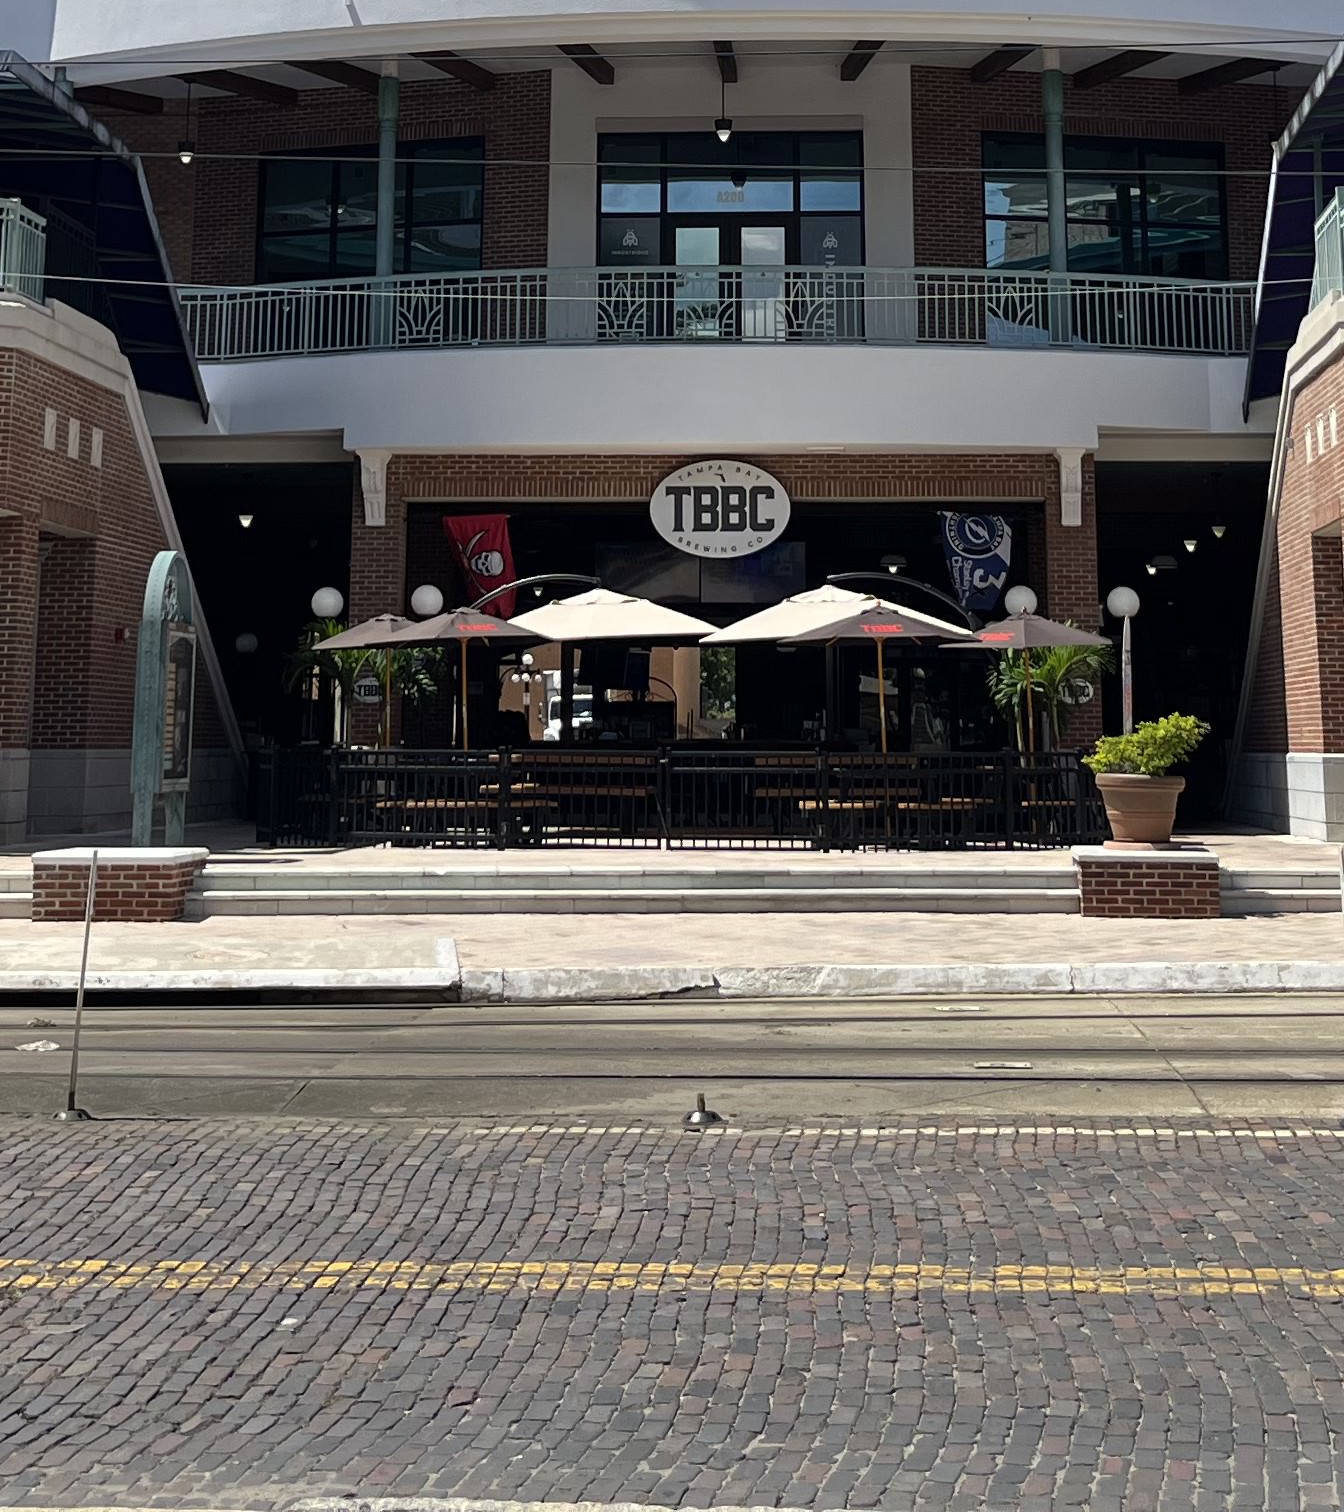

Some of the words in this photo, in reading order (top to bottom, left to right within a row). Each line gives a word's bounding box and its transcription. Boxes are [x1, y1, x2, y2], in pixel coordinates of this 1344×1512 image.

[716, 191, 745, 203] A200
[678, 464, 723, 481] TAMPA
[735, 466, 761, 481] BAY
[665, 485, 775, 532] TBBC
[677, 536, 737, 553] BREWING
[748, 535, 764, 548] CO
[973, 568, 1007, 591] 3
